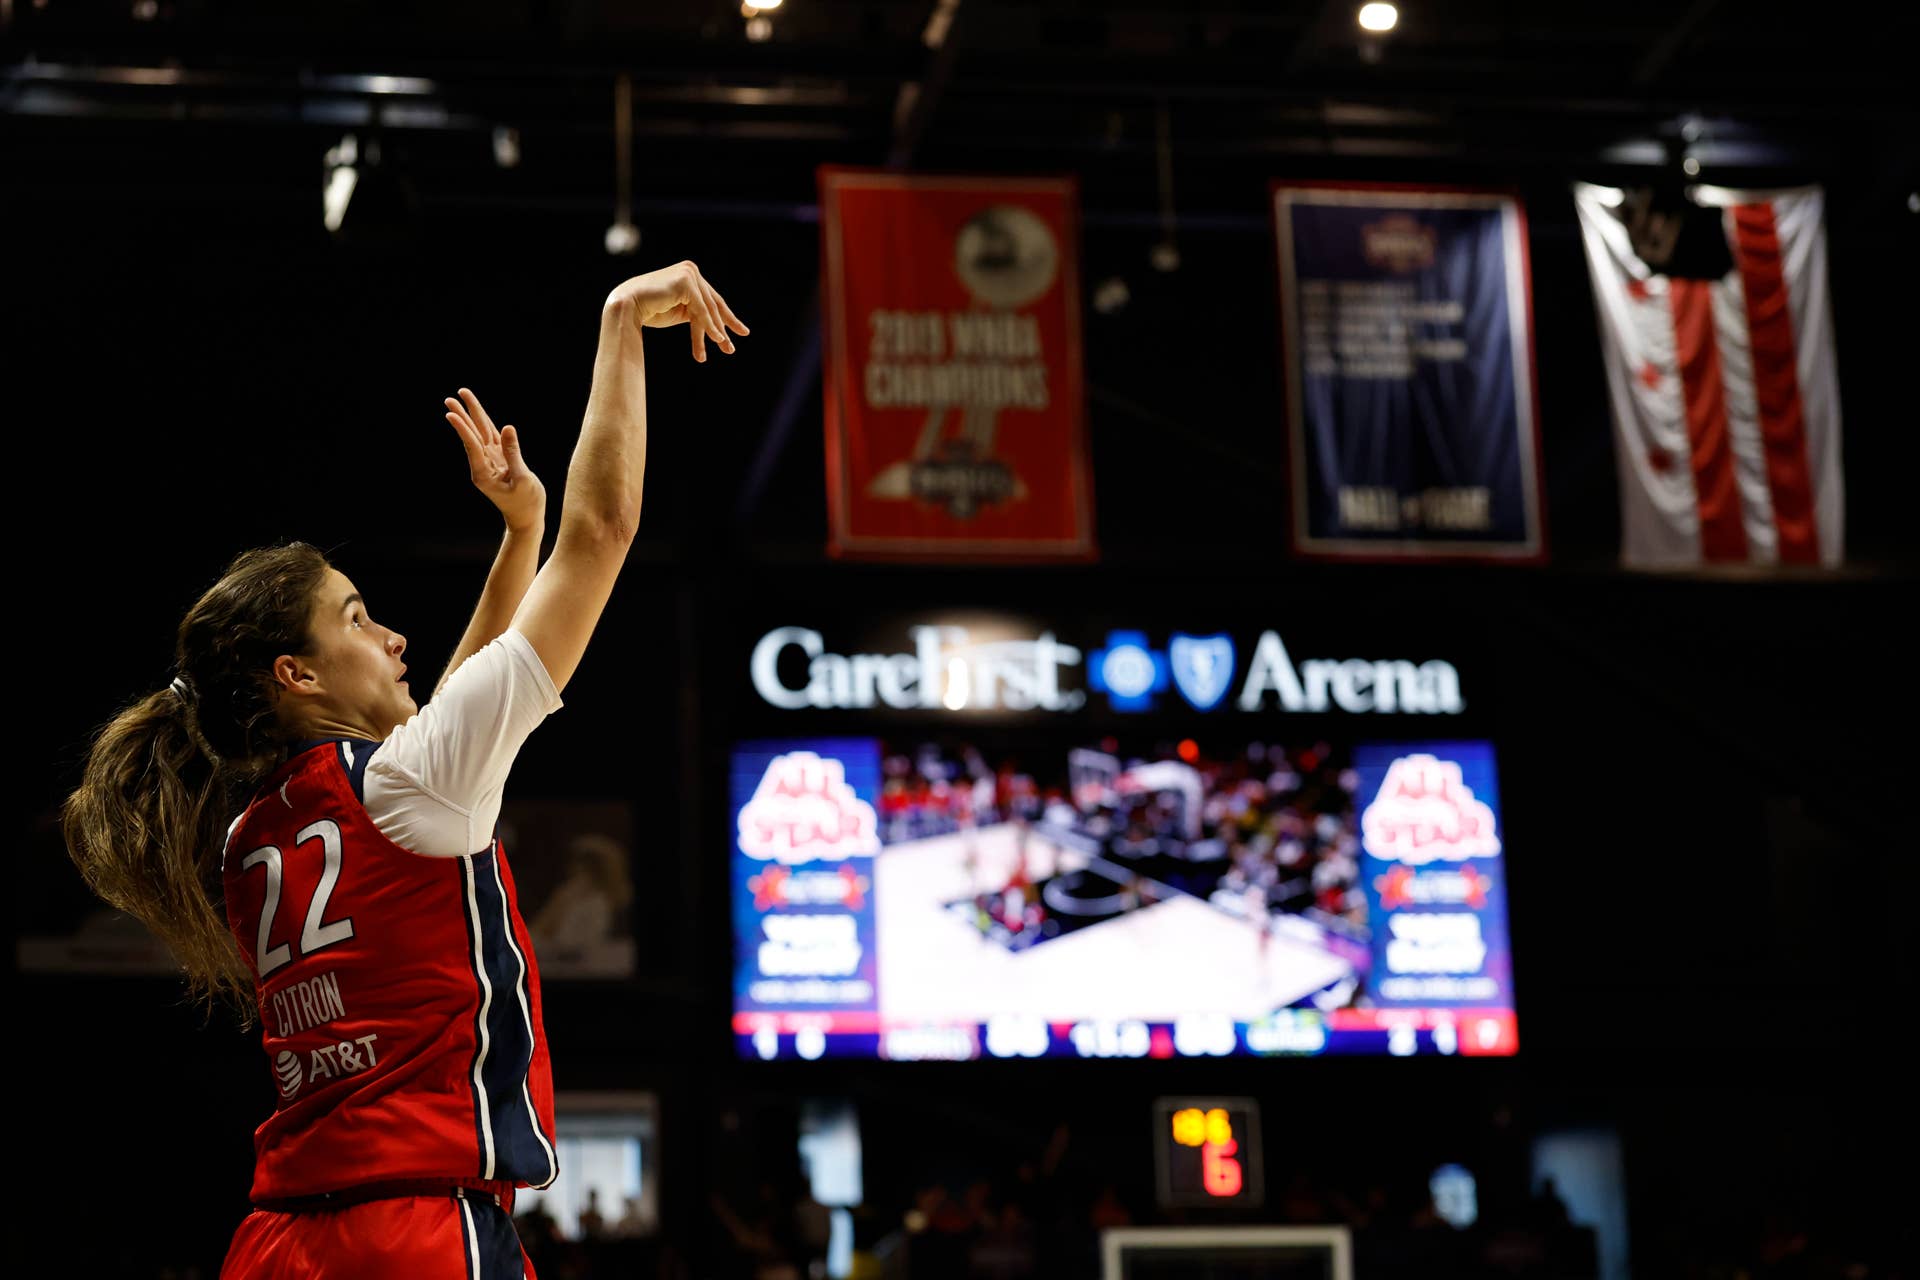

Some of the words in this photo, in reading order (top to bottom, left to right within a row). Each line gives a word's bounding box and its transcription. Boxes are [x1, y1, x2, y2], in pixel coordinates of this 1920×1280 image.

[864, 360, 1049, 412] CHAMPIONS
[1238, 630, 1466, 714] Arena
[243, 818, 354, 979] 22
[273, 971, 346, 1038] CITRON
[309, 1033, 378, 1084] AT&T
[1202, 1140, 1243, 1197] 6
